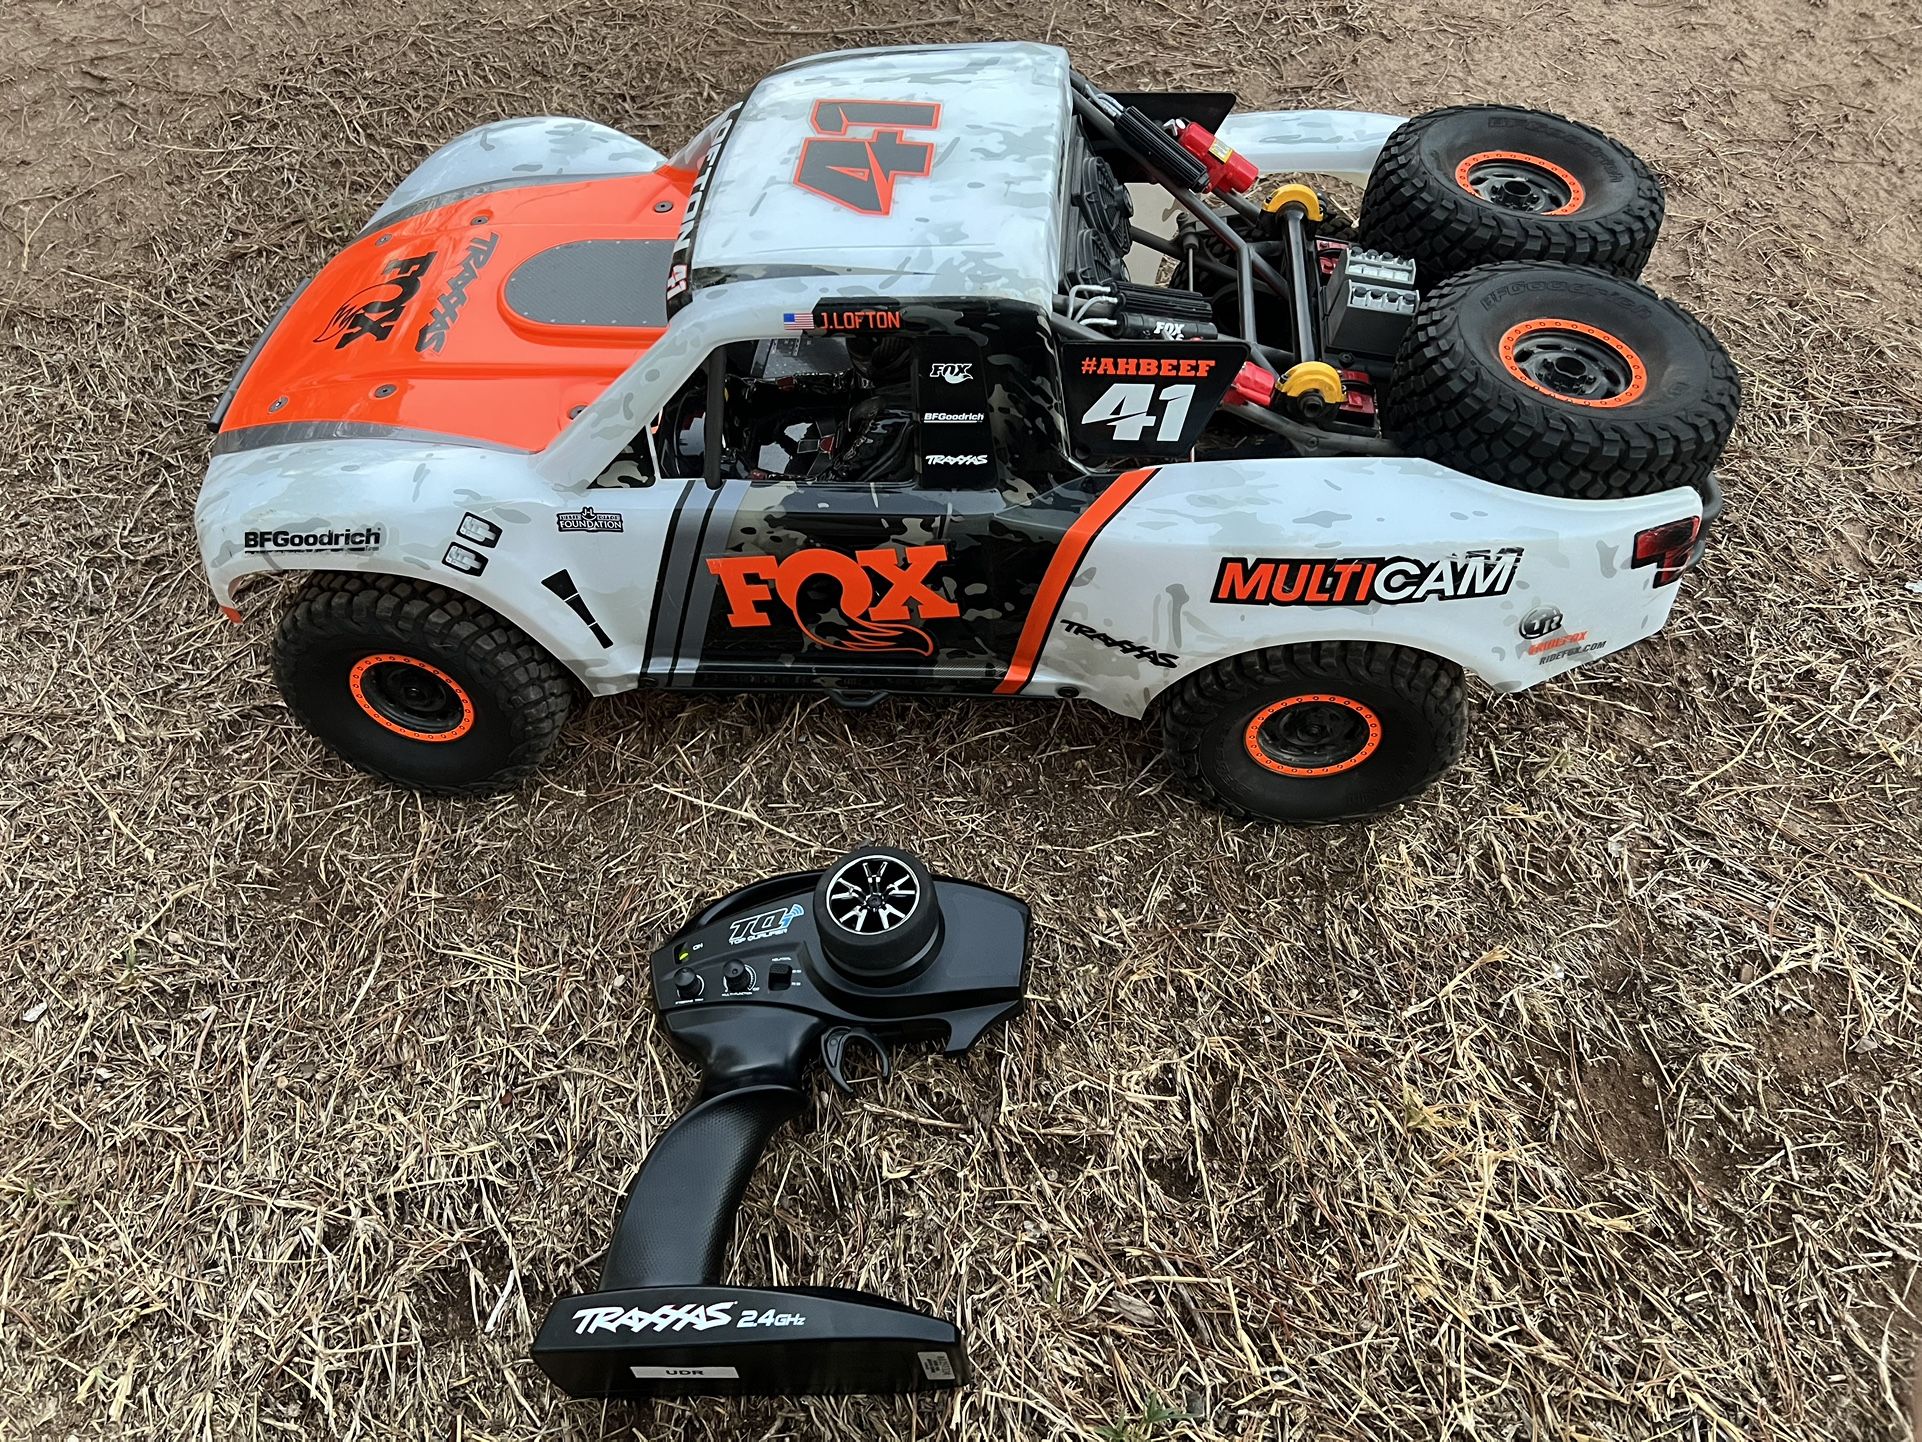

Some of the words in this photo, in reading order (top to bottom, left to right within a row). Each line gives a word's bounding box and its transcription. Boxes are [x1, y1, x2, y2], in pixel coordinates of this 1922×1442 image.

[792, 98, 943, 216] 41
[673, 101, 743, 253] LOFTON
[415, 232, 500, 352] TRAXXAS
[667, 264, 687, 300] 41
[313, 251, 438, 350] FOX
[820, 311, 900, 329] J.LOFTON
[1153, 321, 1186, 340] FOX
[929, 363, 973, 384] FOX
[1081, 357, 1216, 377] #AHBEEF
[923, 412, 984, 423] BFGoodrich
[1081, 383, 1196, 441] 41
[925, 454, 988, 466] TRAXXAS
[244, 527, 381, 549] BFGoodrich
[559, 520, 622, 529] FOUNDATION
[1215, 551, 1520, 602] MULTICAM
[706, 544, 960, 657] FOX
[1061, 619, 1177, 669] TRAXXAS
[1539, 641, 1607, 665] RIDEFOX.COM
[572, 1302, 736, 1334] TRAXXAS
[736, 1309, 806, 1328] 2.4GHz
